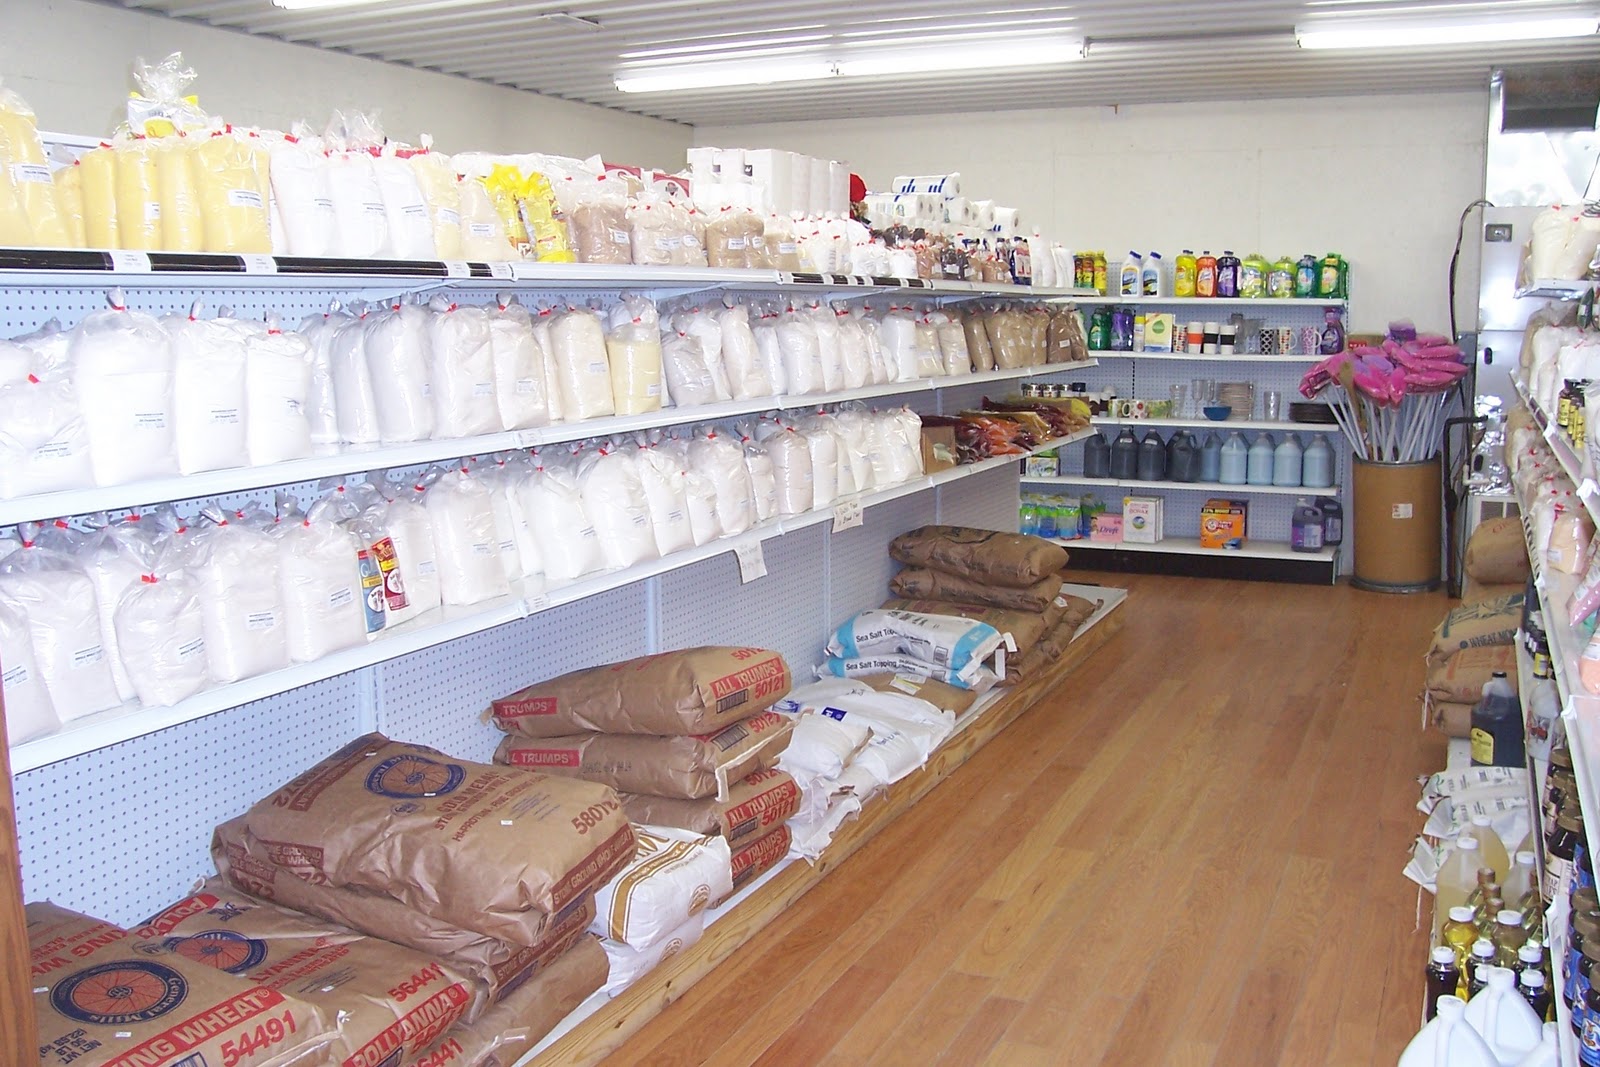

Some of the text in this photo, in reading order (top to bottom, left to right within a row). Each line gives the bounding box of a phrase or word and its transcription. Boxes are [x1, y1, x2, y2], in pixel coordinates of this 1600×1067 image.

[856, 633, 869, 643] Sea
[870, 629, 882, 639] Salt
[715, 662, 777, 697] ALL TRUMPS
[846, 662, 858, 671] Sea
[859, 660, 871, 669] Salt
[873, 660, 897, 669] Topping
[755, 674, 784, 699] 50121
[503, 701, 548, 715] TRUMPS
[521, 753, 569, 764] TRUMPS
[436, 795, 469, 813] GOLD
[571, 801, 618, 834] 58072
[729, 807, 745, 824] ALL
[761, 797, 795, 826] 50121
[748, 831, 784, 865] TRUMPS
[571, 860, 598, 888] GROUND
[387, 962, 445, 1002] 56441
[89, 976, 182, 1025] General Mills
[172, 992, 265, 1045] WHEAT
[350, 992, 454, 1067] POLLYANNA
[55, 1045, 72, 1056] LB
[80, 1040, 102, 1053] NET
[220, 1009, 297, 1067] 54491
[409, 1037, 464, 1067] 6441
